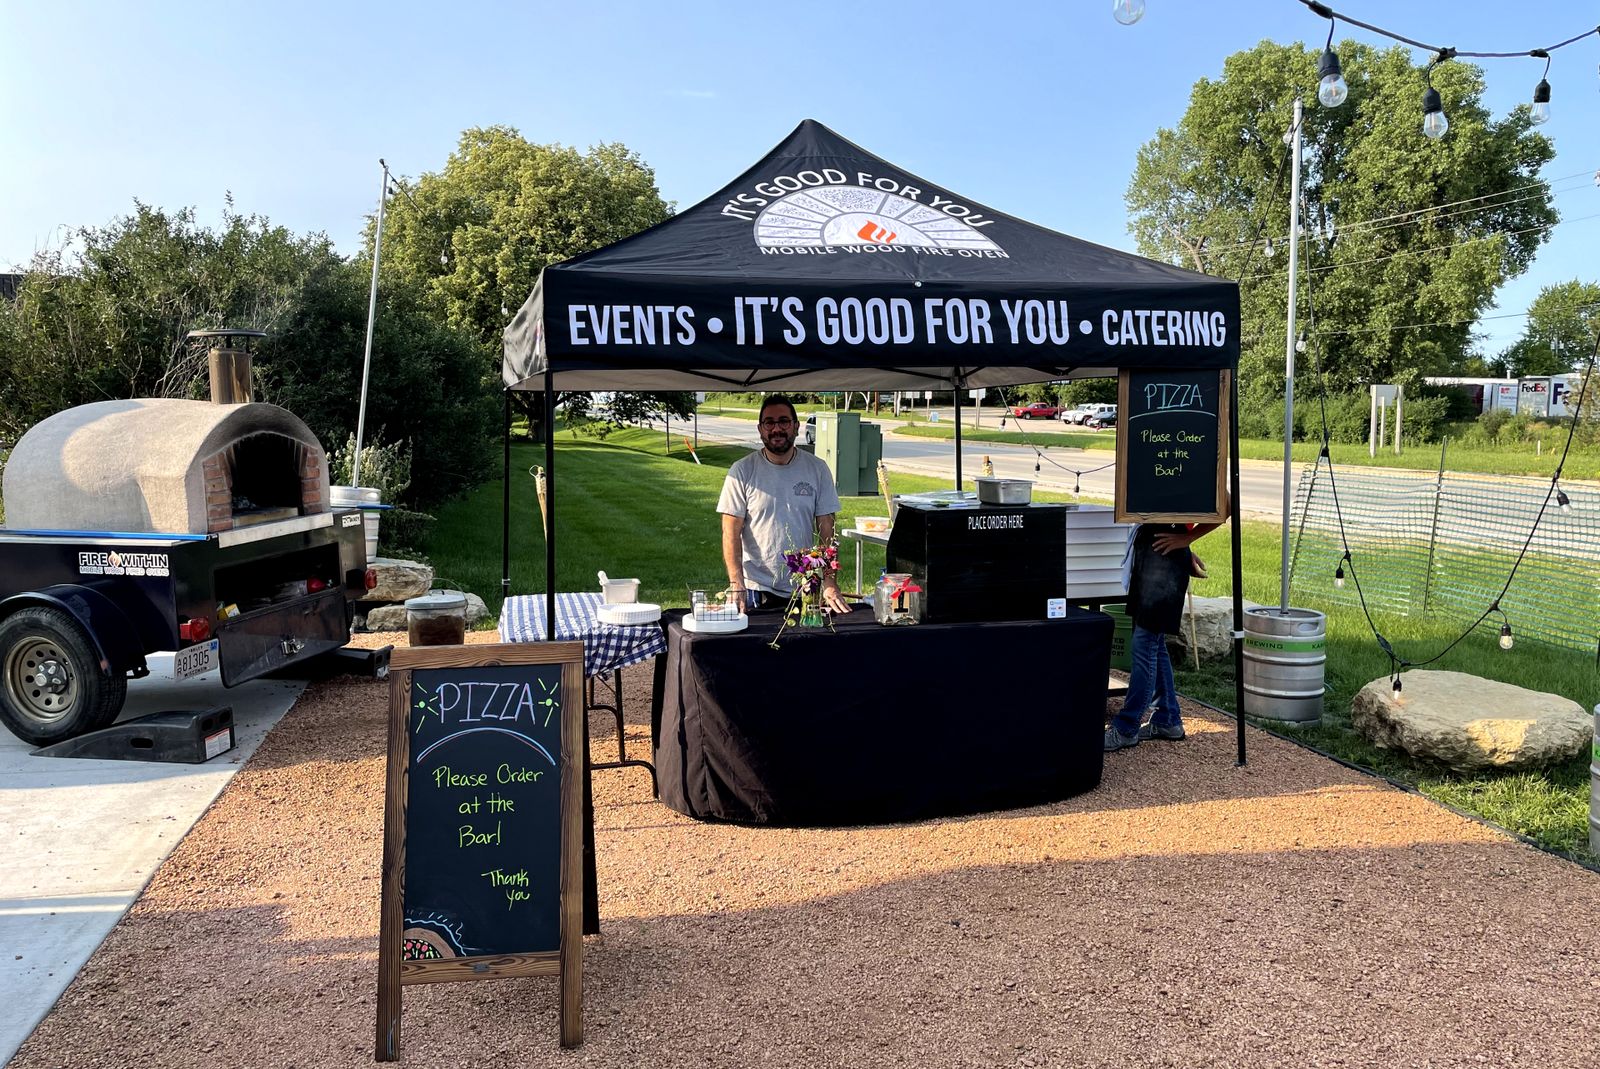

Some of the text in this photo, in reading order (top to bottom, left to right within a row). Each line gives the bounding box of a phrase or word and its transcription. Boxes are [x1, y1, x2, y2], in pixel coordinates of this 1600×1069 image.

[720, 168, 995, 227] IT'S GOOD FOR YOU
[758, 244, 1011, 259] MOBILE WOOD FIRE OVEN
[567, 295, 1227, 348] EVENTS IT'S GOOD FOR YOU CATERING
[1144, 383, 1204, 410] PIZZA
[1521, 383, 1547, 393] FedEx
[1140, 429, 1206, 443] Please Order
[1157, 448, 1190, 459] at the
[1154, 463, 1183, 477] Bar!
[968, 514, 1024, 530] PLACE ORDER HERE
[79, 552, 169, 568] FIRE WITHIN
[182, 649, 210, 672] 81305
[436, 682, 536, 725] PIZZA
[432, 763, 544, 788] Please Order
[459, 792, 515, 815] at the
[458, 820, 502, 848] Bar!
[481, 868, 530, 888] Thank
[505, 889, 531, 911] you
